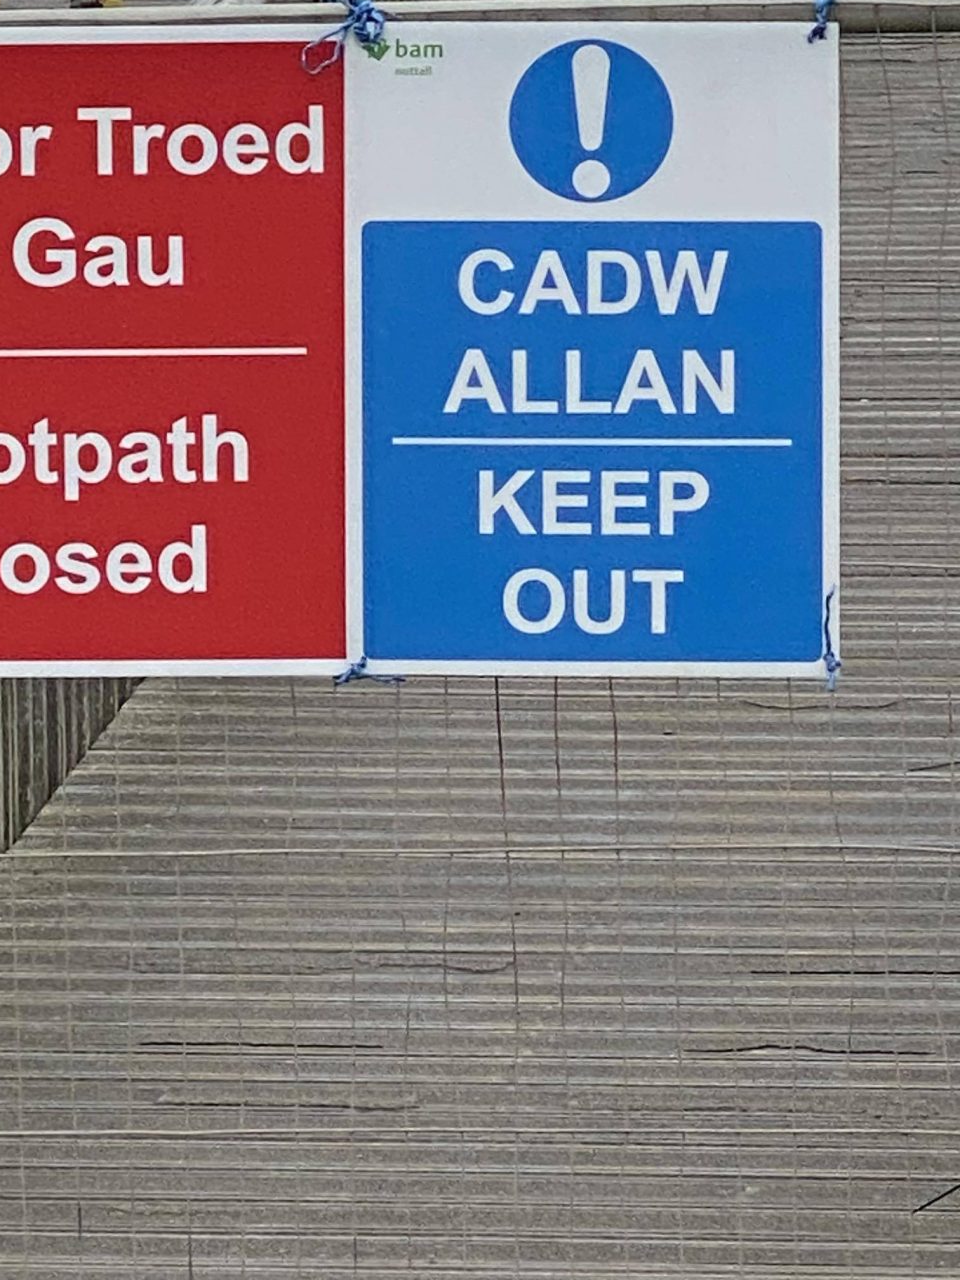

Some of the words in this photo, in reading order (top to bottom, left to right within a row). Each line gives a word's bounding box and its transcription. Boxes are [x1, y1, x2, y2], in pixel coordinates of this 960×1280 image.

[395, 38, 443, 58] bam
[77, 104, 326, 176] Troed
[11, 215, 185, 288] Gau
[457, 248, 729, 316] CADW
[442, 349, 736, 415] ALLAN
[477, 469, 710, 536] KEEP
[502, 568, 684, 636] OUT
